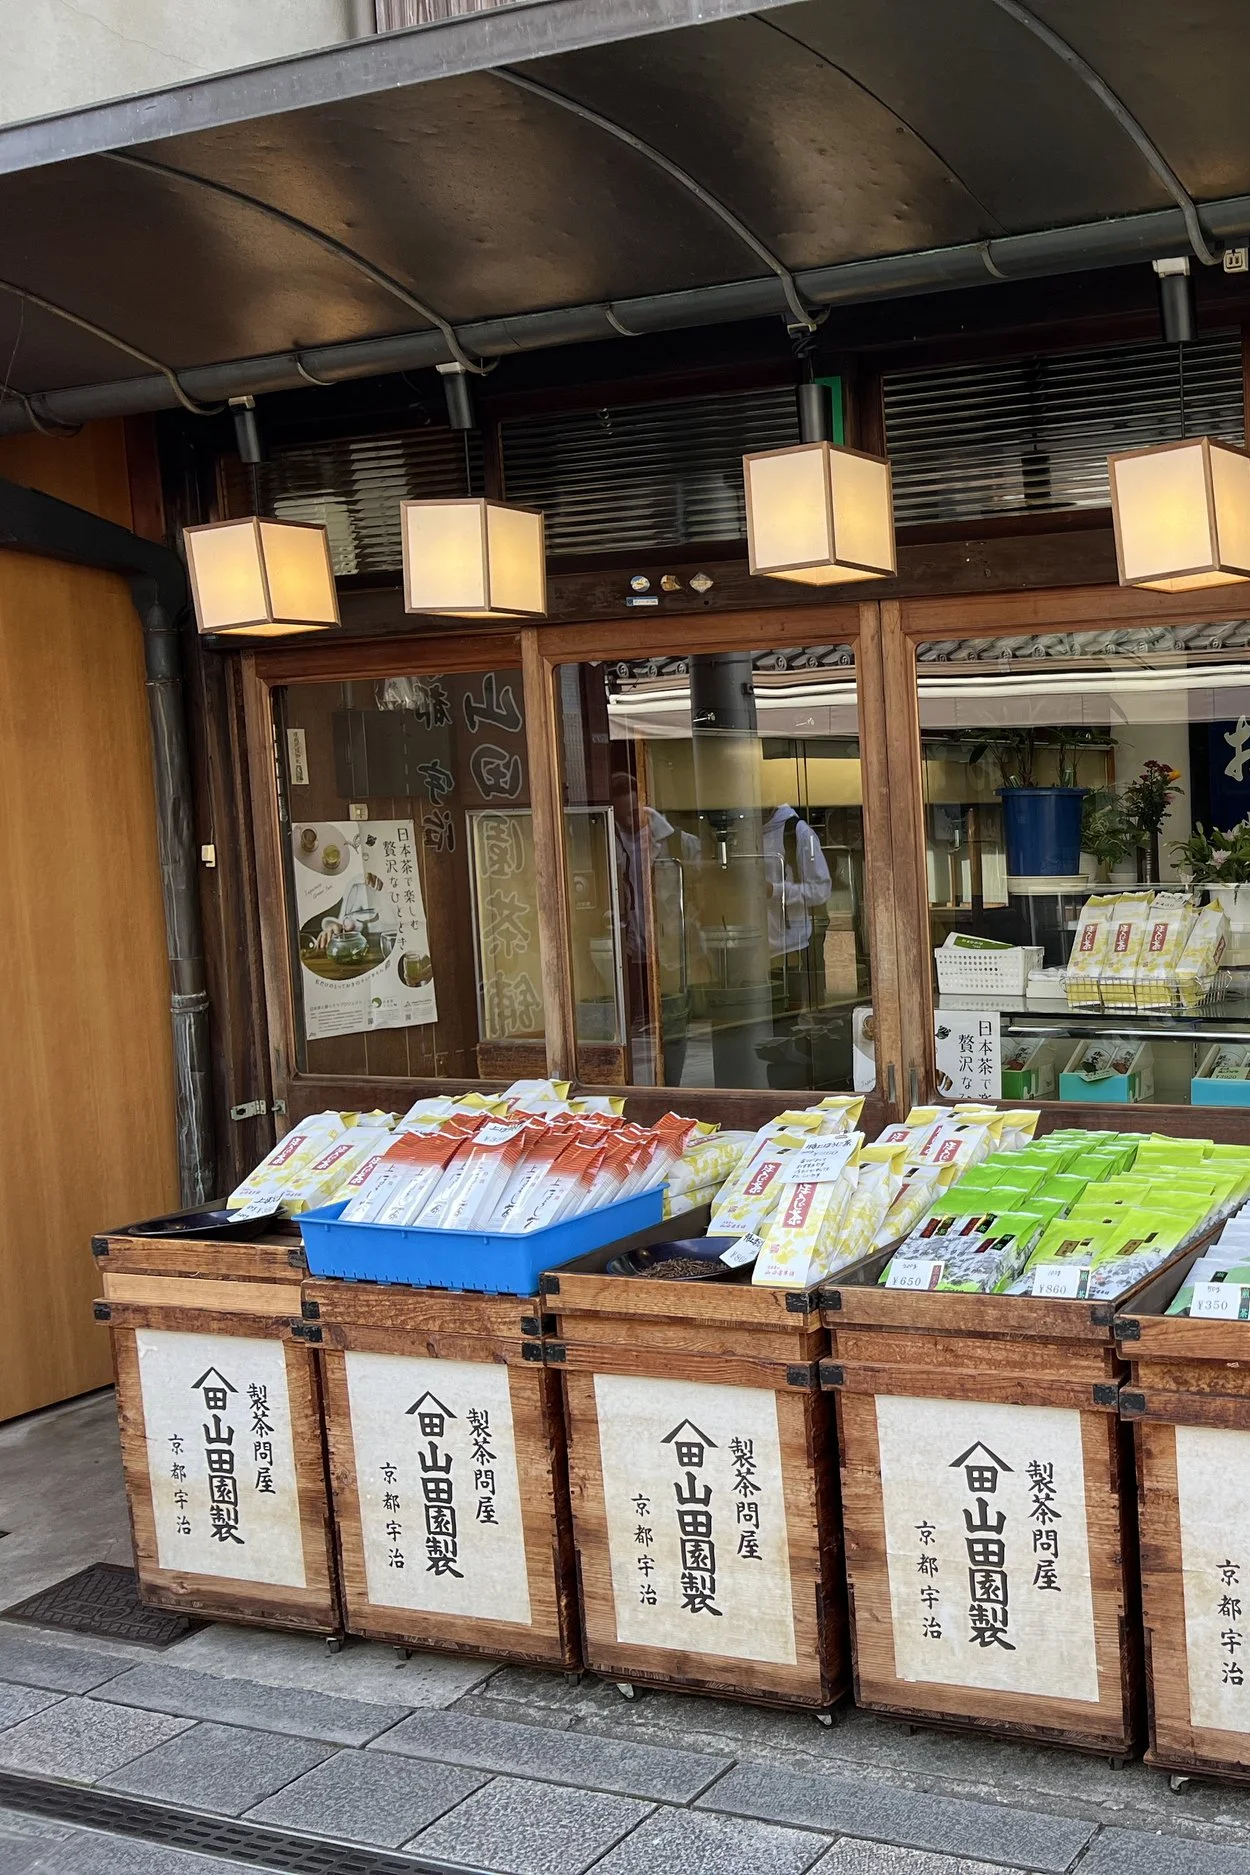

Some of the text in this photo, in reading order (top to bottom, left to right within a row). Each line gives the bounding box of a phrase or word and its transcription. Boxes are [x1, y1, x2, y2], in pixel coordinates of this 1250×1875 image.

[893, 1276, 921, 1286] ¥650
[1040, 1284, 1067, 1294] ¥860
[1198, 1301, 1229, 1310] ¥350
[168, 1434, 191, 1534] 京都宇治
[247, 1383, 275, 1494] 製茶問屋
[467, 1408, 498, 1524] 製茶問屋
[380, 1462, 404, 1568] 京都宇治
[632, 1494, 657, 1605] 京都宇治
[729, 1437, 762, 1560] 製茶問屋
[1026, 1460, 1061, 1591] 製茶問屋
[916, 1521, 942, 1638] 京都宇治
[1216, 1560, 1243, 1685] 京都宇治
